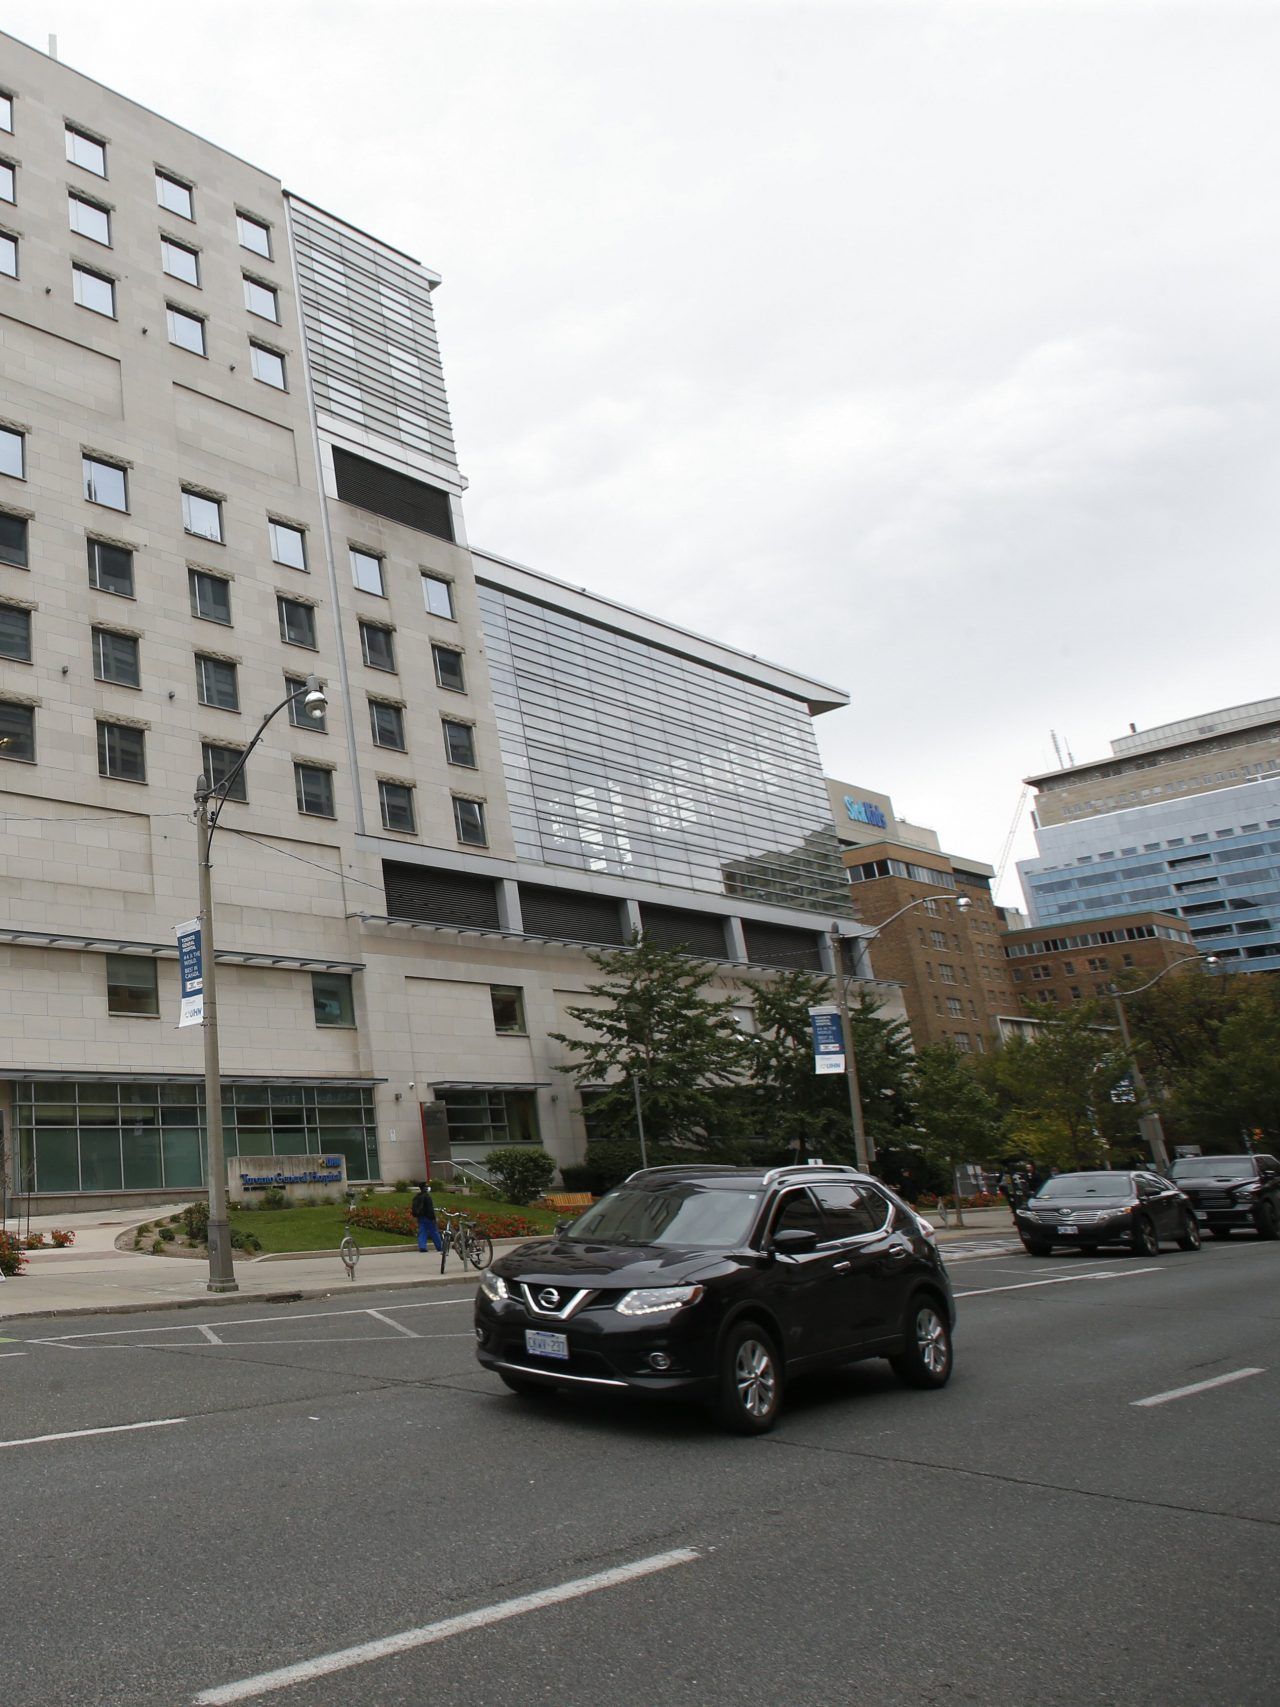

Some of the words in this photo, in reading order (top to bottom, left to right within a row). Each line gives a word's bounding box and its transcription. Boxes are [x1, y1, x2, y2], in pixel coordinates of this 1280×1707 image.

[240, 1174, 273, 1186] Toronto
[274, 1171, 308, 1184] General
[310, 1170, 342, 1187] Hospital
